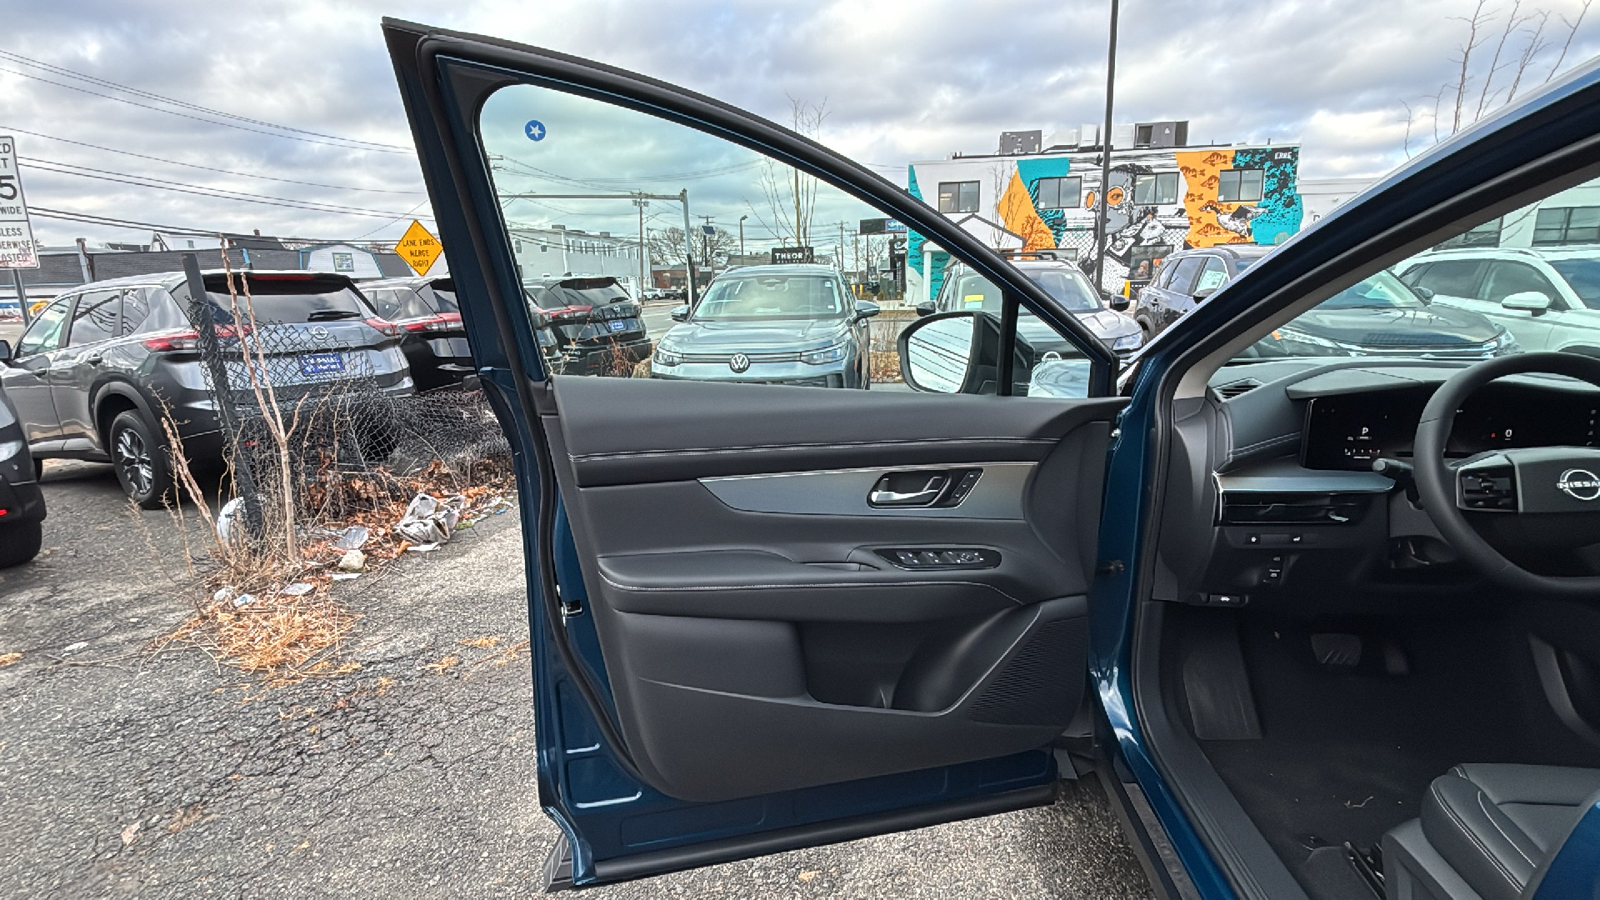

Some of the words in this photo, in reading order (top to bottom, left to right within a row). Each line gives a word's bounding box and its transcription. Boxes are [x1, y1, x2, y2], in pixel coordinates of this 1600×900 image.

[0, 143, 11, 154] D
[0, 175, 18, 200] 5
[0, 228, 23, 237] LESS
[0, 240, 32, 249] ERWISE
[402, 239, 418, 247] LANE
[419, 238, 435, 246] ENDS
[409, 249, 431, 257] MERGE
[412, 259, 430, 267] RIGHT
[1361, 427, 1369, 435] P
[1556, 481, 1600, 489] NISSA
